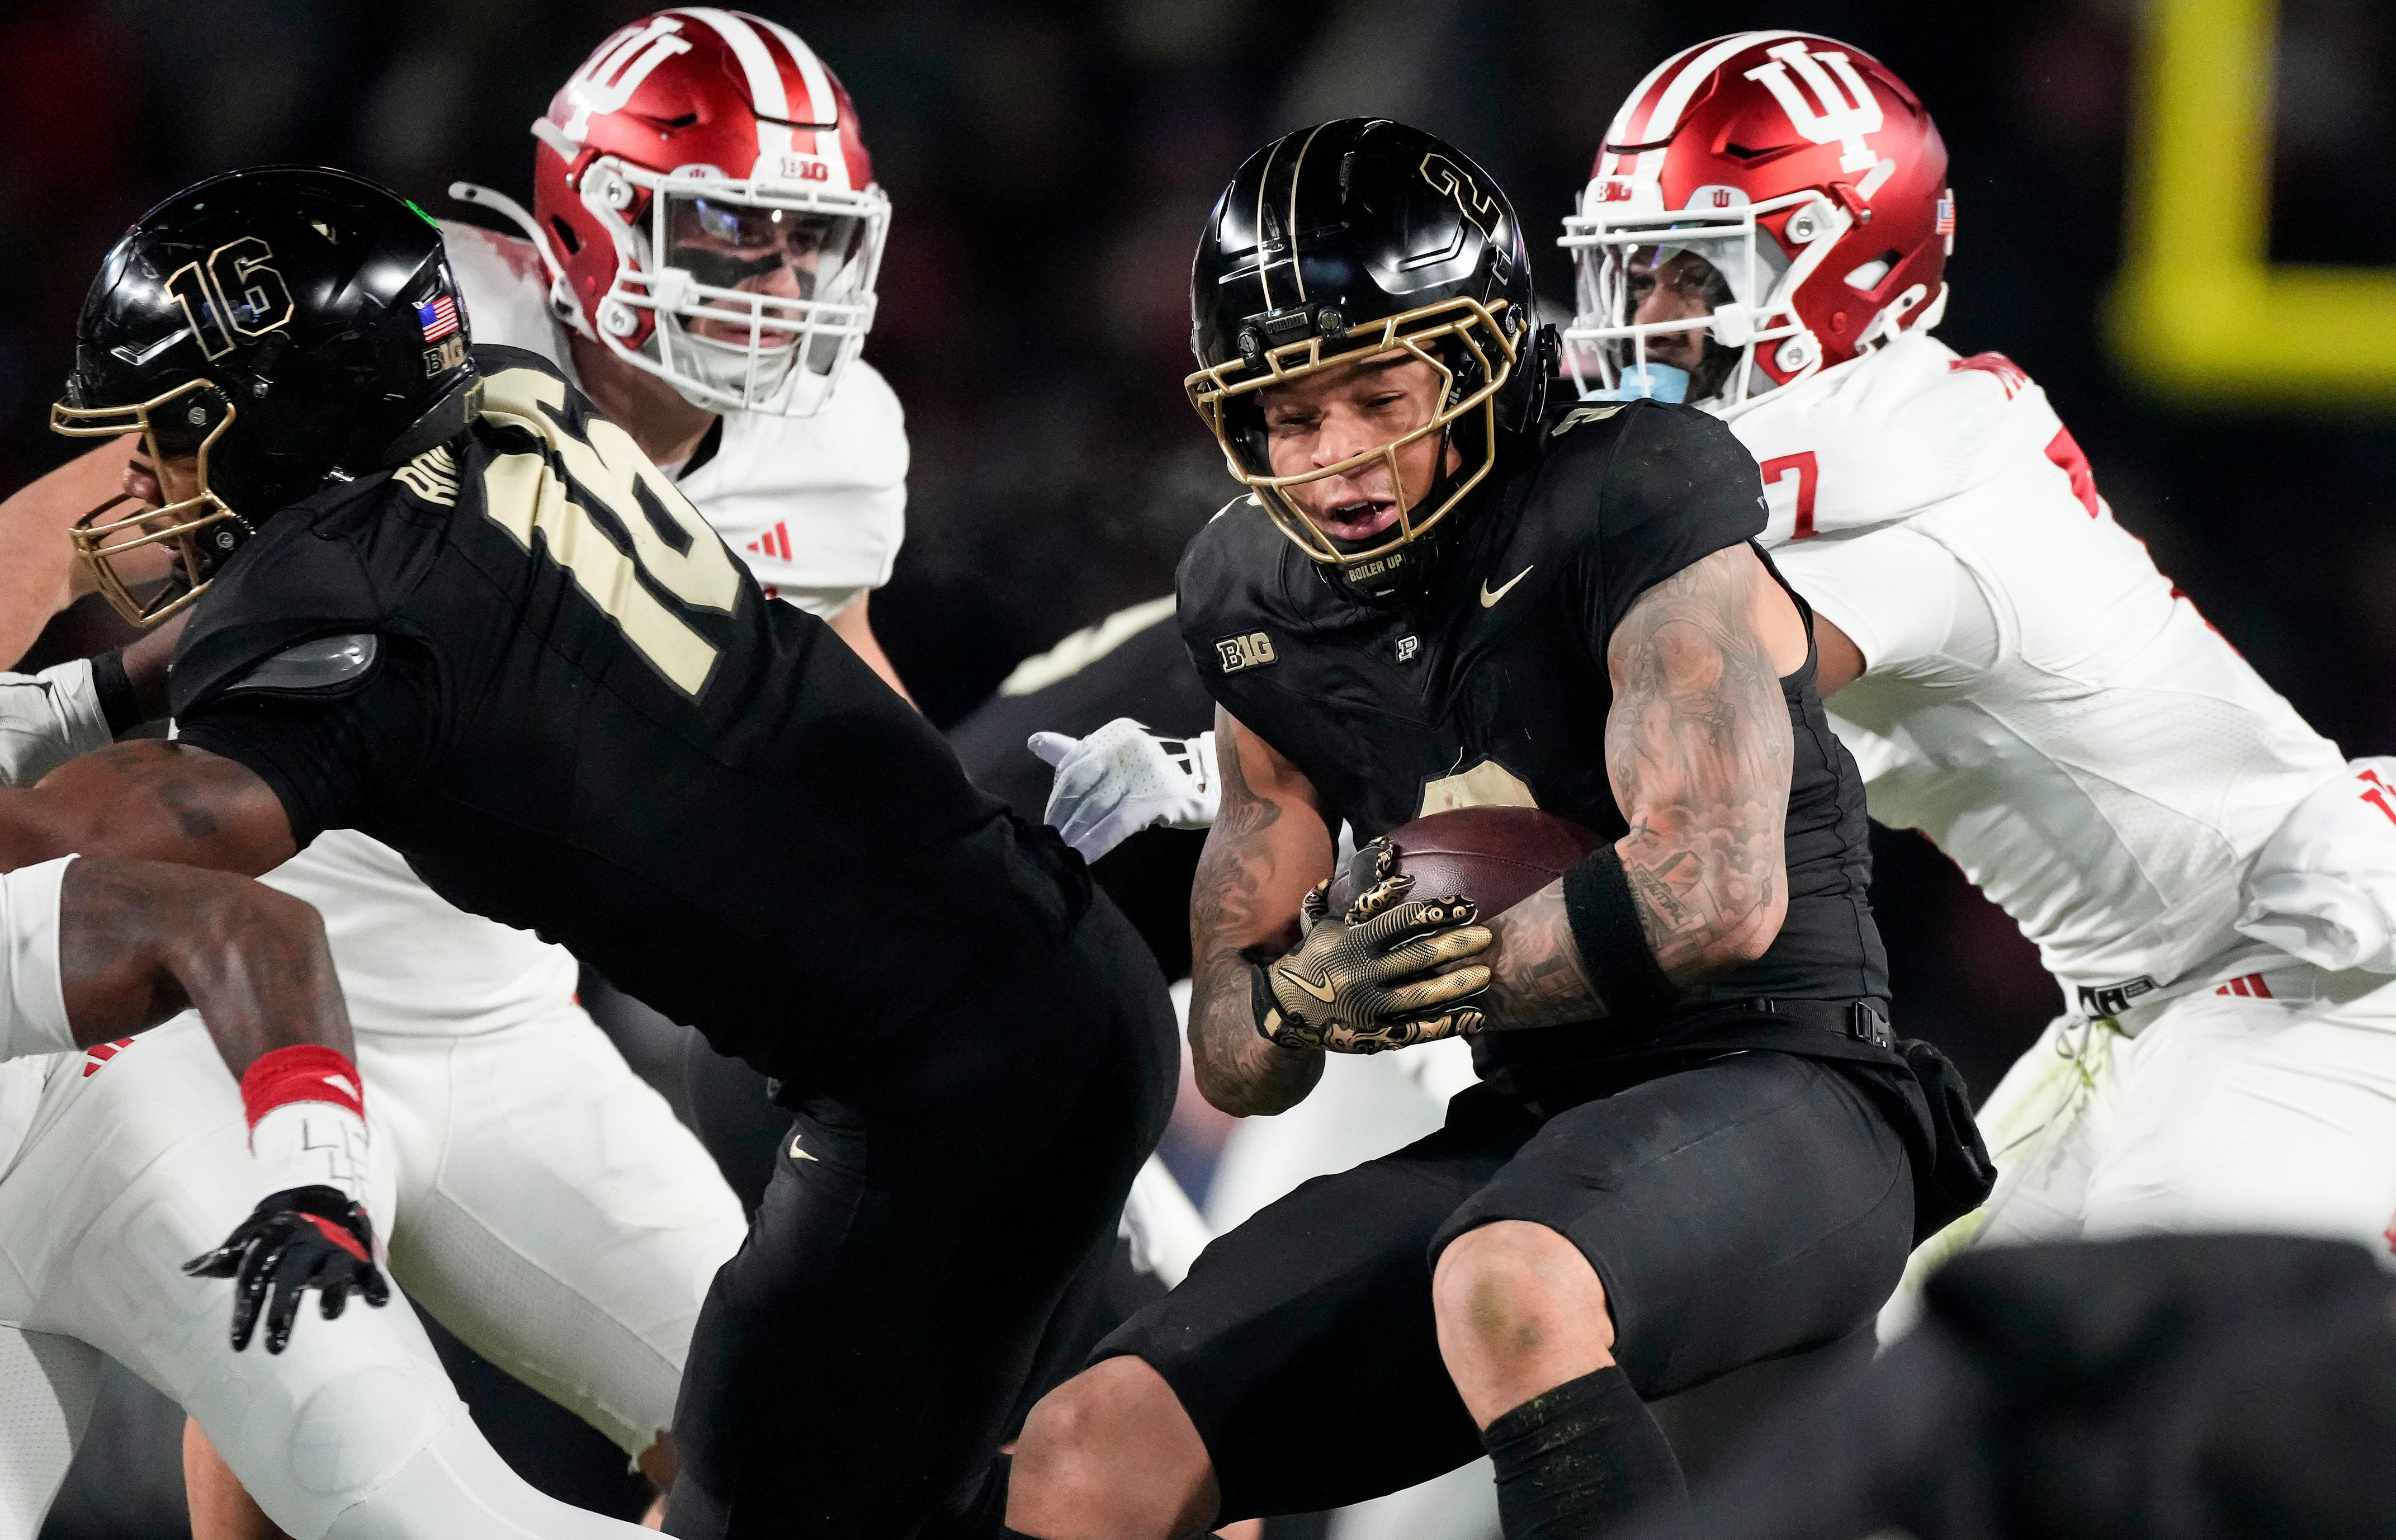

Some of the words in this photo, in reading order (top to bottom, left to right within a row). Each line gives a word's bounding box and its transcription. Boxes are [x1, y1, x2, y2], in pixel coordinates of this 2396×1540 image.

[1419, 153, 1504, 243] 2
[164, 236, 295, 361] 16
[1265, 312, 1308, 334] PURDUE
[482, 367, 744, 703] 16
[1348, 560, 1385, 582] BOILER
[1386, 554, 1402, 569] UP
[1398, 635, 1417, 662] P
